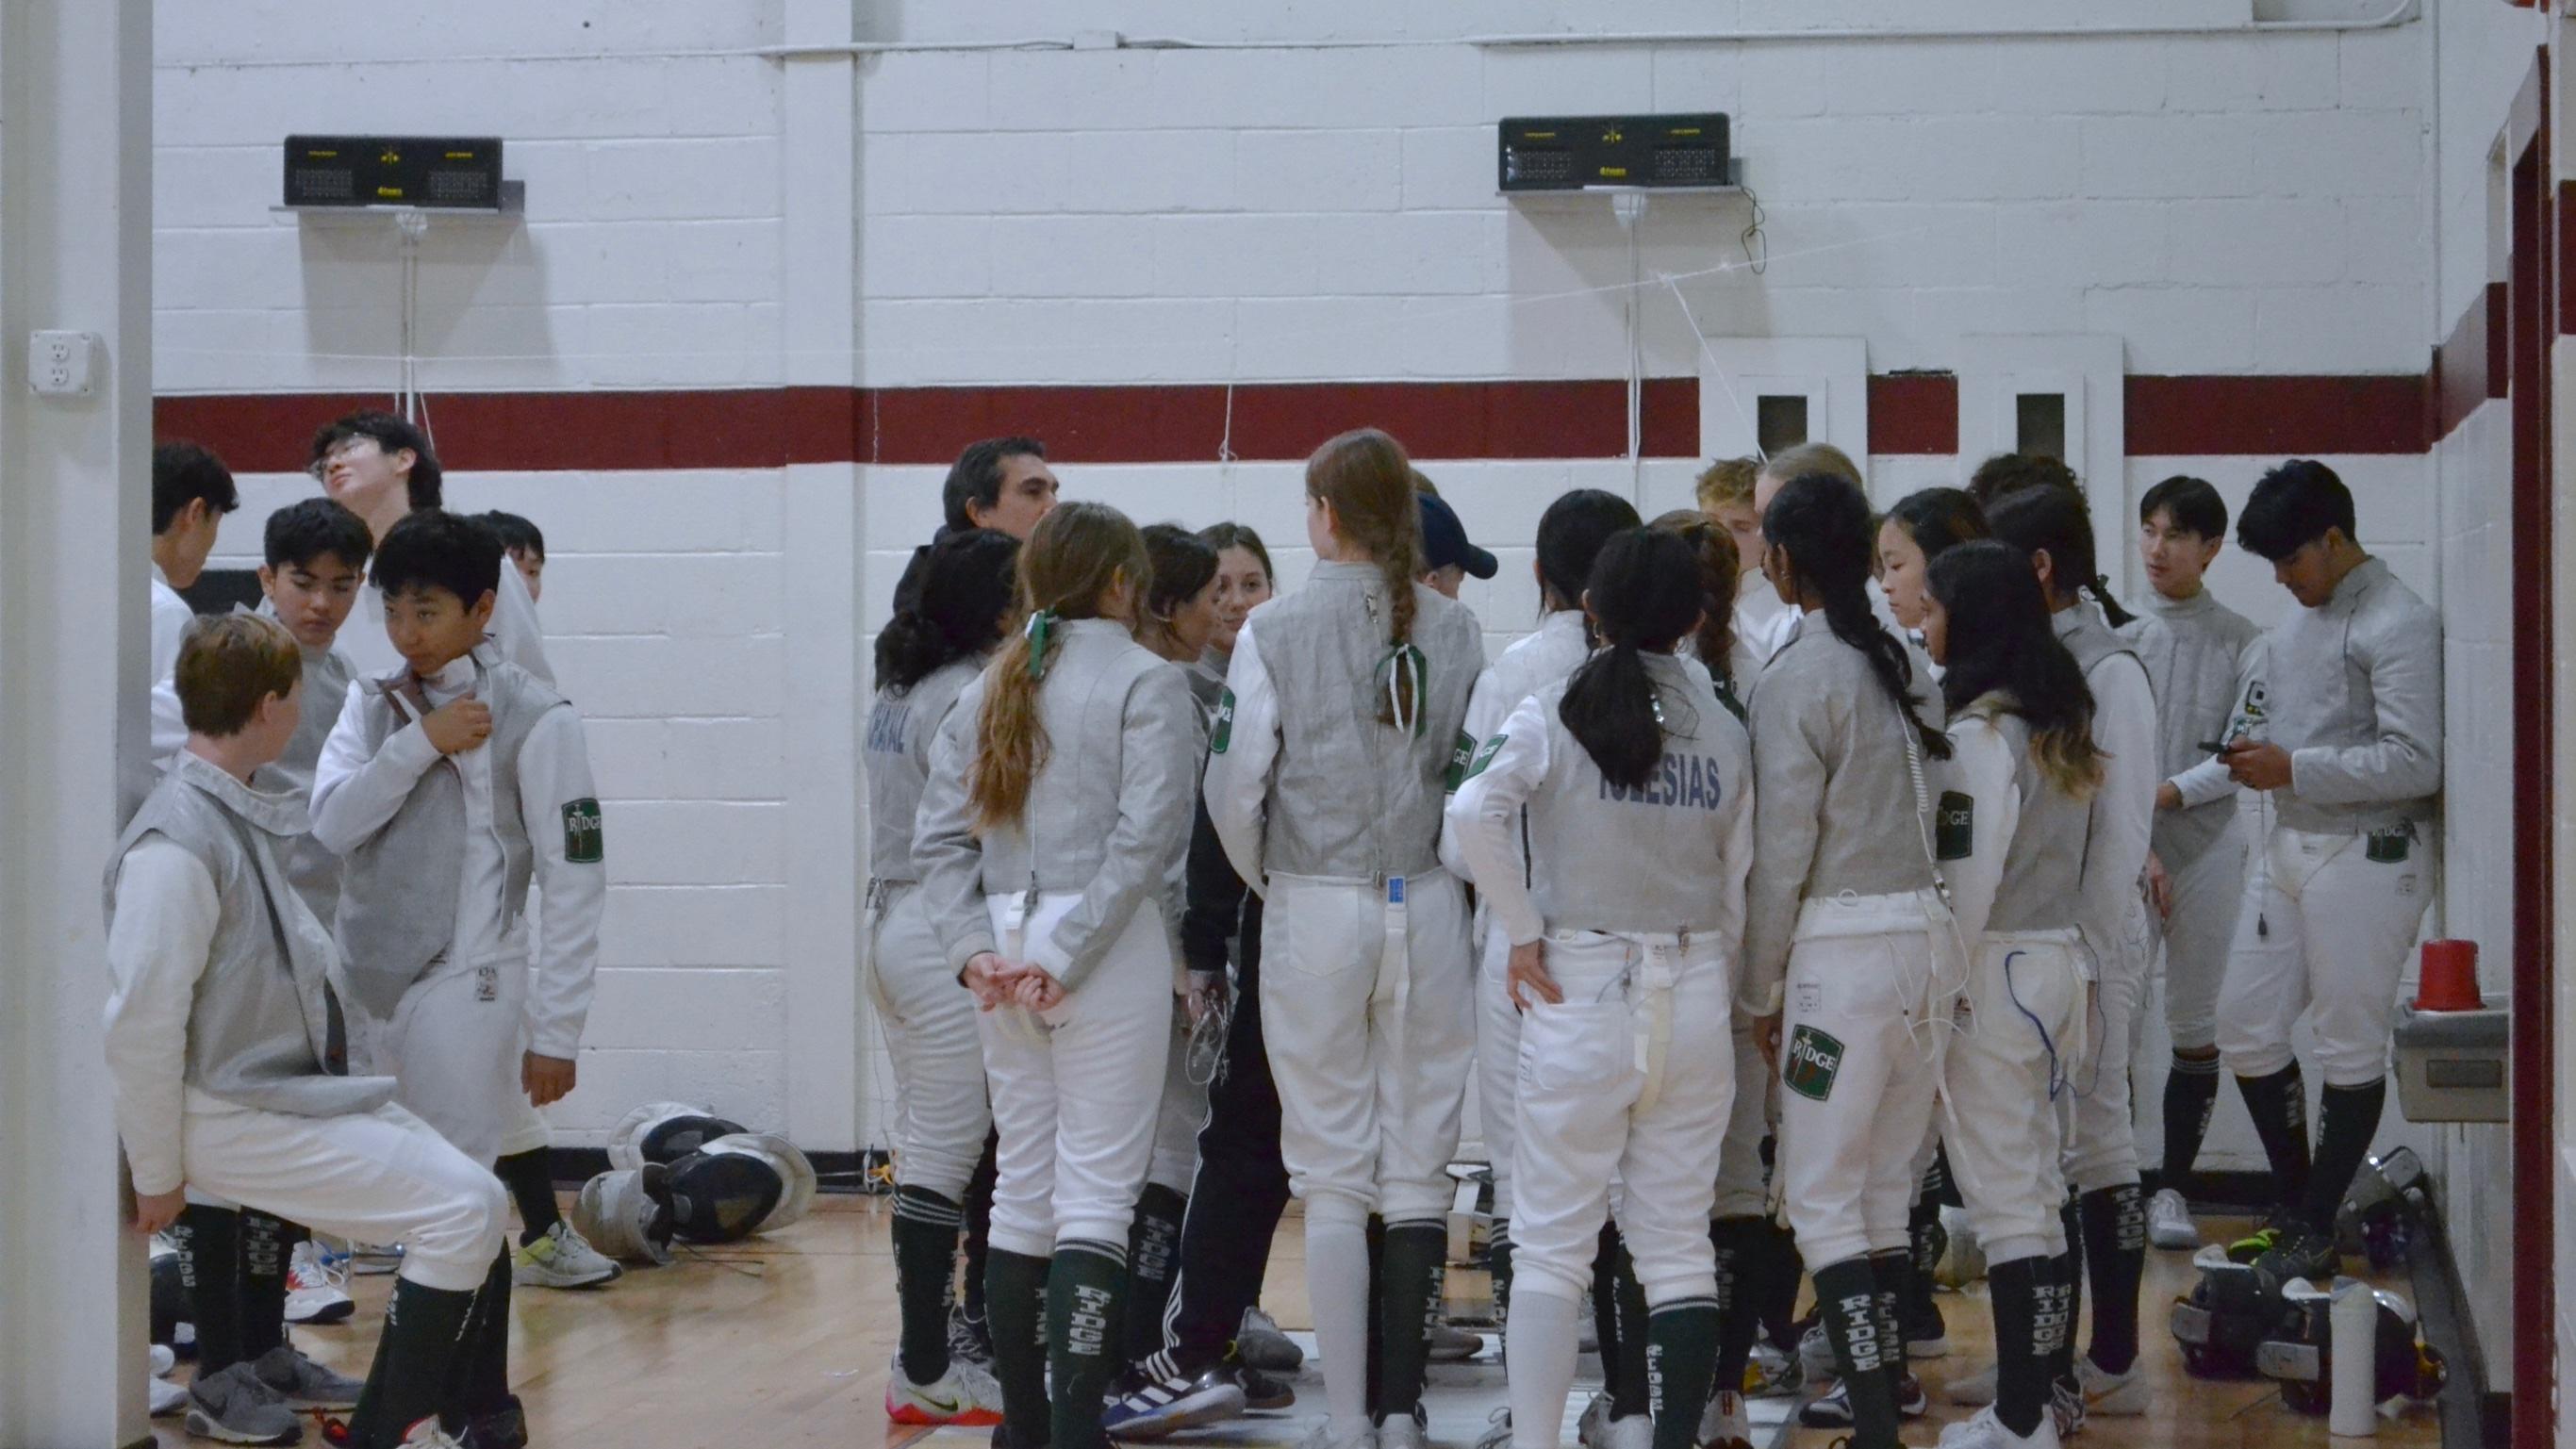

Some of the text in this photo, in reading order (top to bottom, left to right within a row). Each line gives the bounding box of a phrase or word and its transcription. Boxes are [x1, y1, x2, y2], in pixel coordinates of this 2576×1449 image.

[1792, 1038, 1836, 1071] RIDGE
[1137, 1214, 1177, 1281] RIDGE
[1067, 1284, 1112, 1356] RIDGE
[1839, 1293, 1881, 1372] RIDGE
